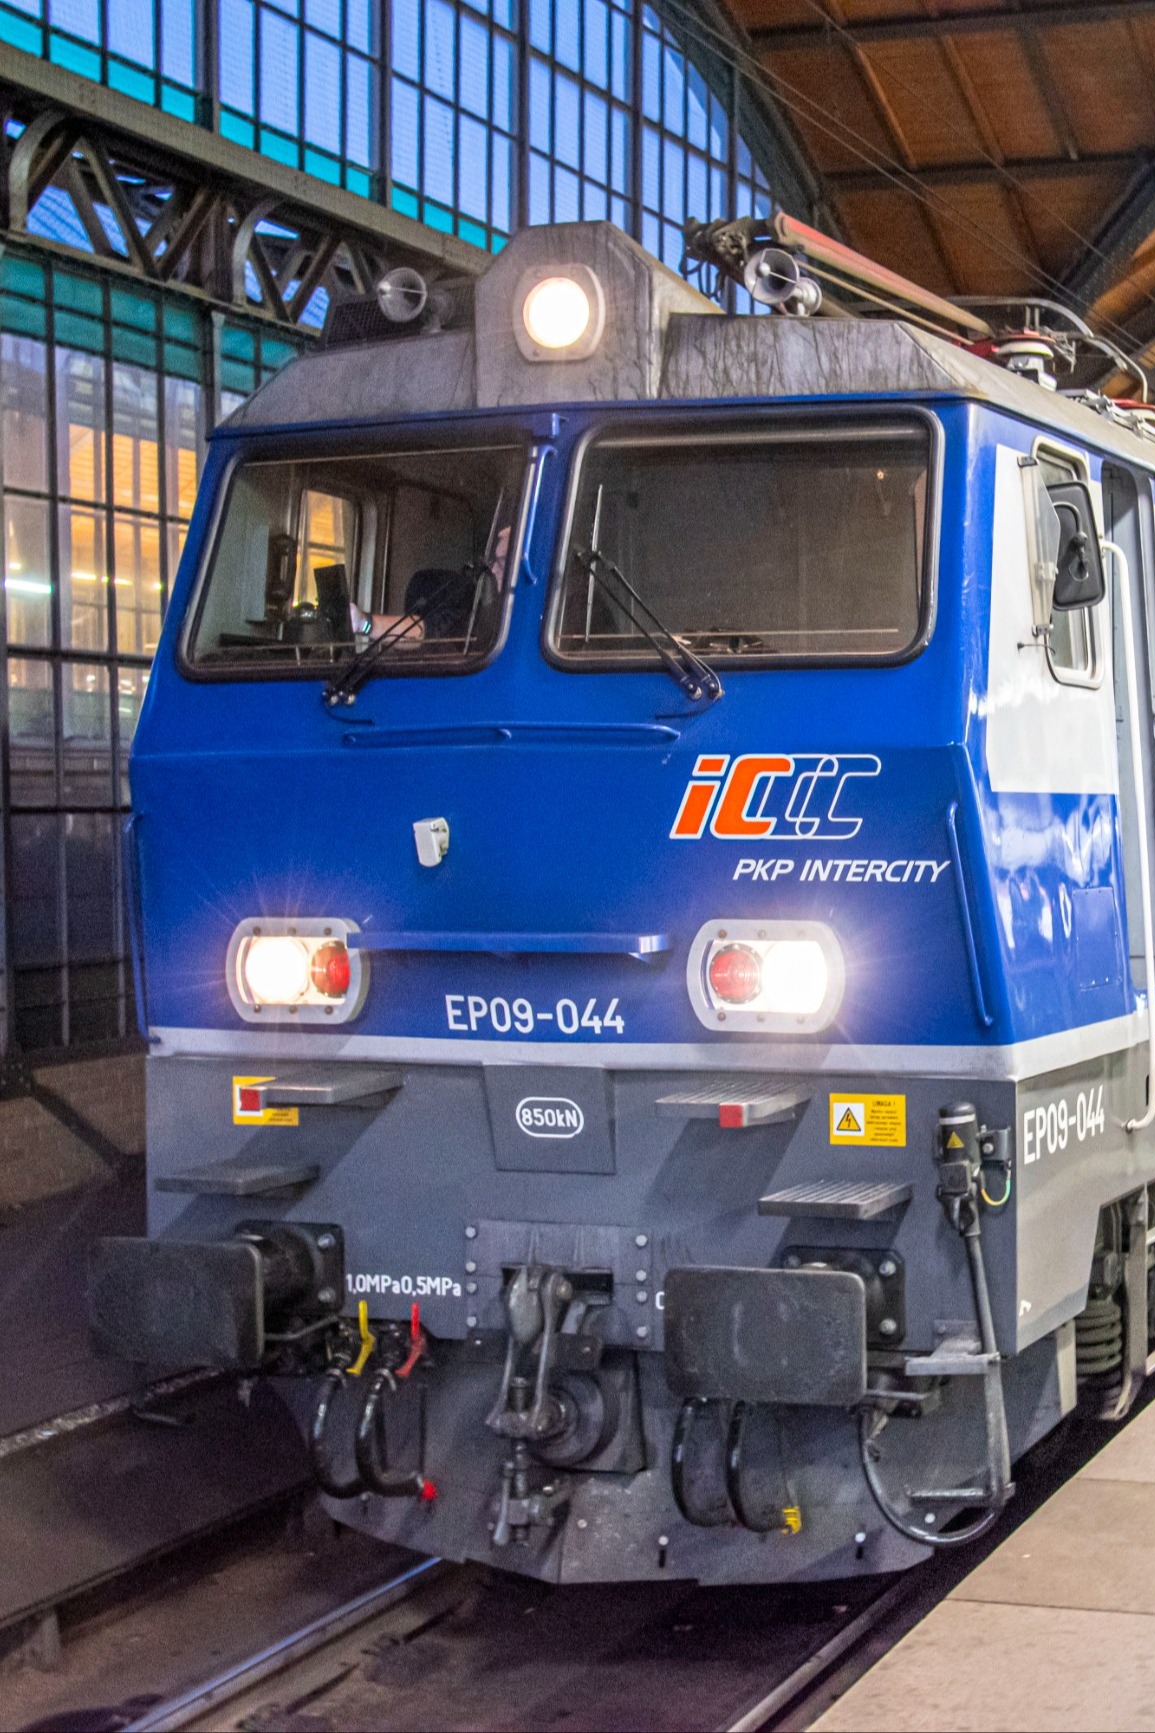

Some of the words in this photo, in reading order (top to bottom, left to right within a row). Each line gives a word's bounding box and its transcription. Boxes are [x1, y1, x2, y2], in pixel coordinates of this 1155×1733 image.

[732, 858, 795, 882] PKP
[798, 859, 951, 883] INTERCITY
[445, 994, 625, 1035] EP09-044
[521, 1108, 578, 1127] 850kN
[1023, 1084, 1105, 1165] EP09-044
